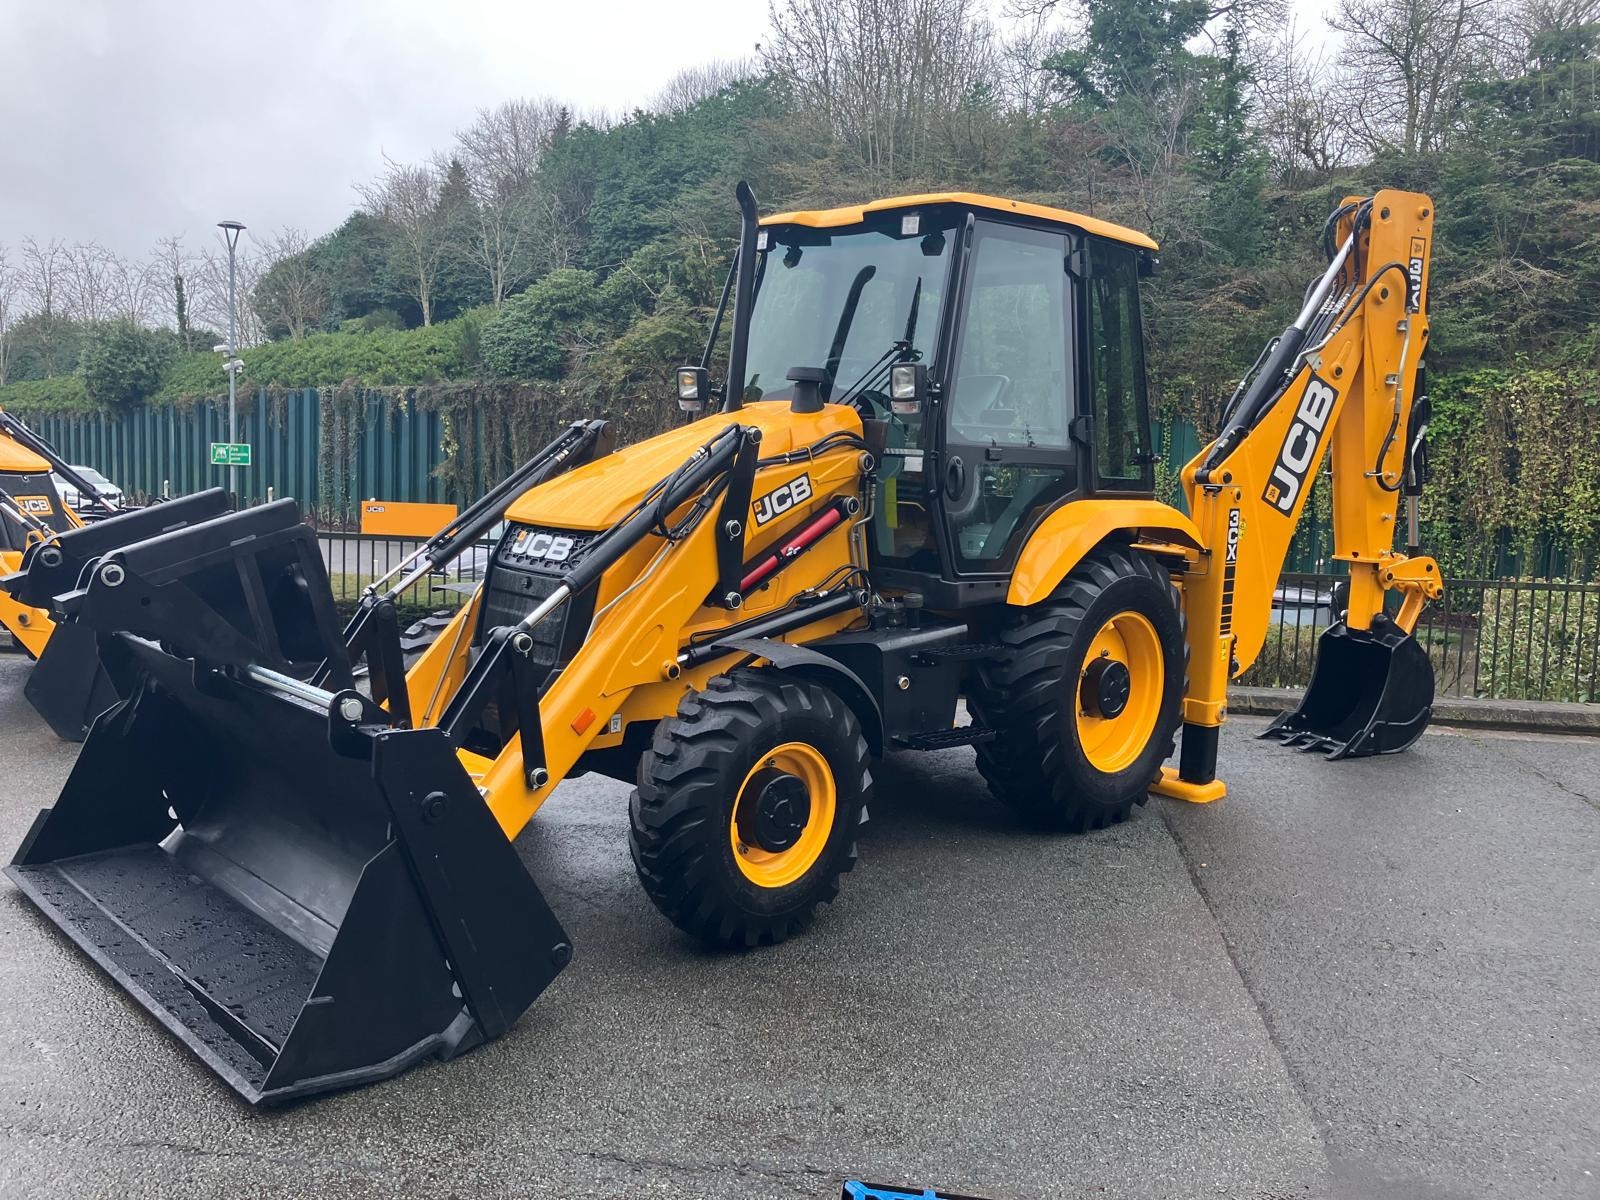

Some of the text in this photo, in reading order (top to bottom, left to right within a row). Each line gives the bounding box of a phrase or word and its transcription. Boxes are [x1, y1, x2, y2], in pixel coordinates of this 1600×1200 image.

[1278, 380, 1334, 511] JCB
[22, 500, 50, 511] JCB
[756, 476, 811, 523] JCB
[511, 532, 574, 561] JCB
[1226, 510, 1240, 561] 3CX
